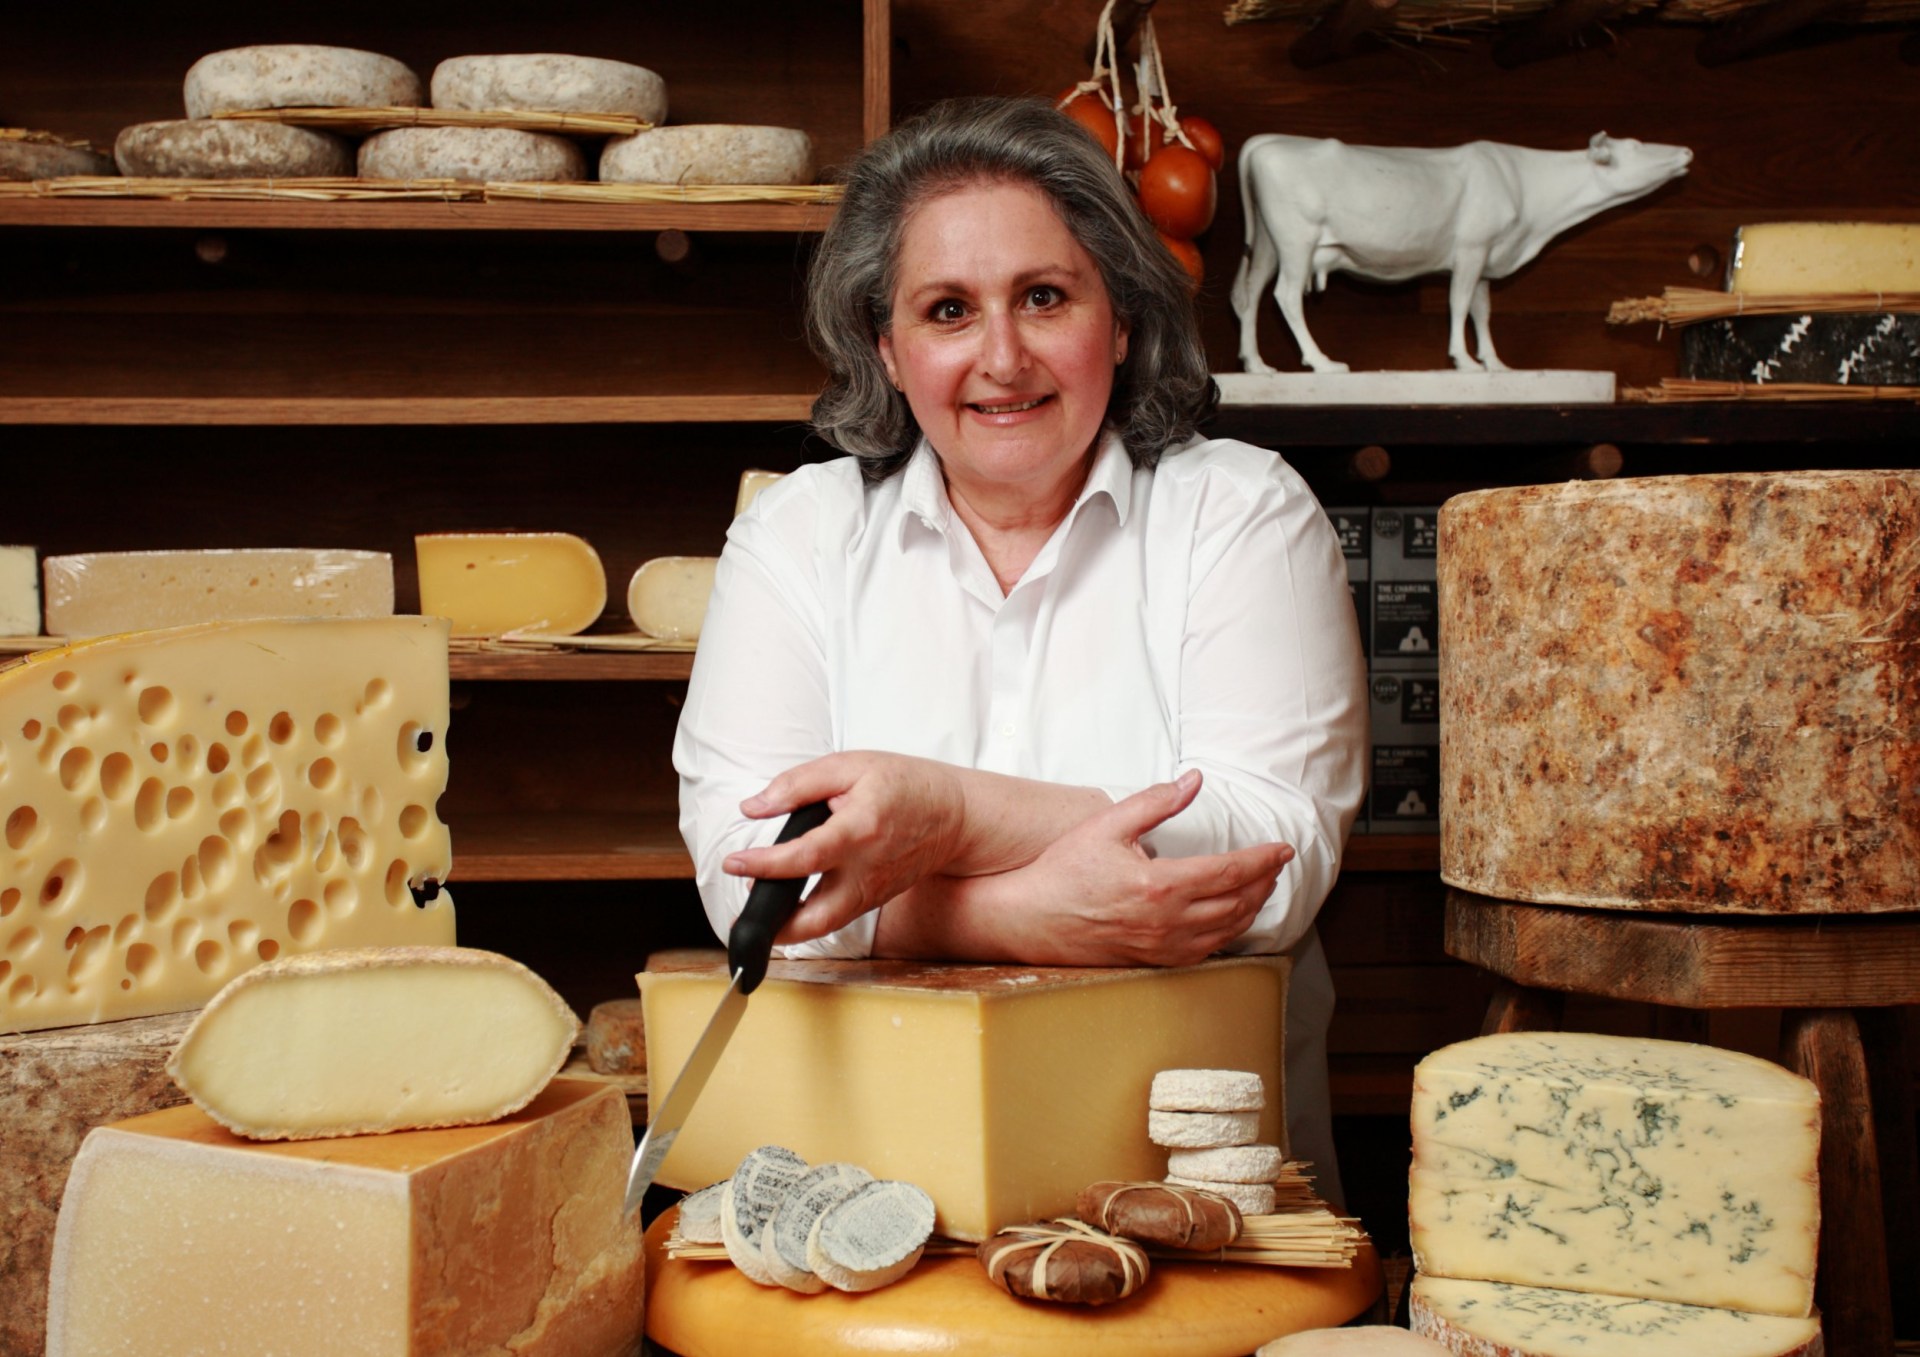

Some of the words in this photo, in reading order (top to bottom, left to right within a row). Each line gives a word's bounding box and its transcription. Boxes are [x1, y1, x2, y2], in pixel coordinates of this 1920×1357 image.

[1377, 584, 1392, 593] THE
[1394, 584, 1431, 593] CHARCOAL
[1377, 594, 1406, 602] BISCUIT
